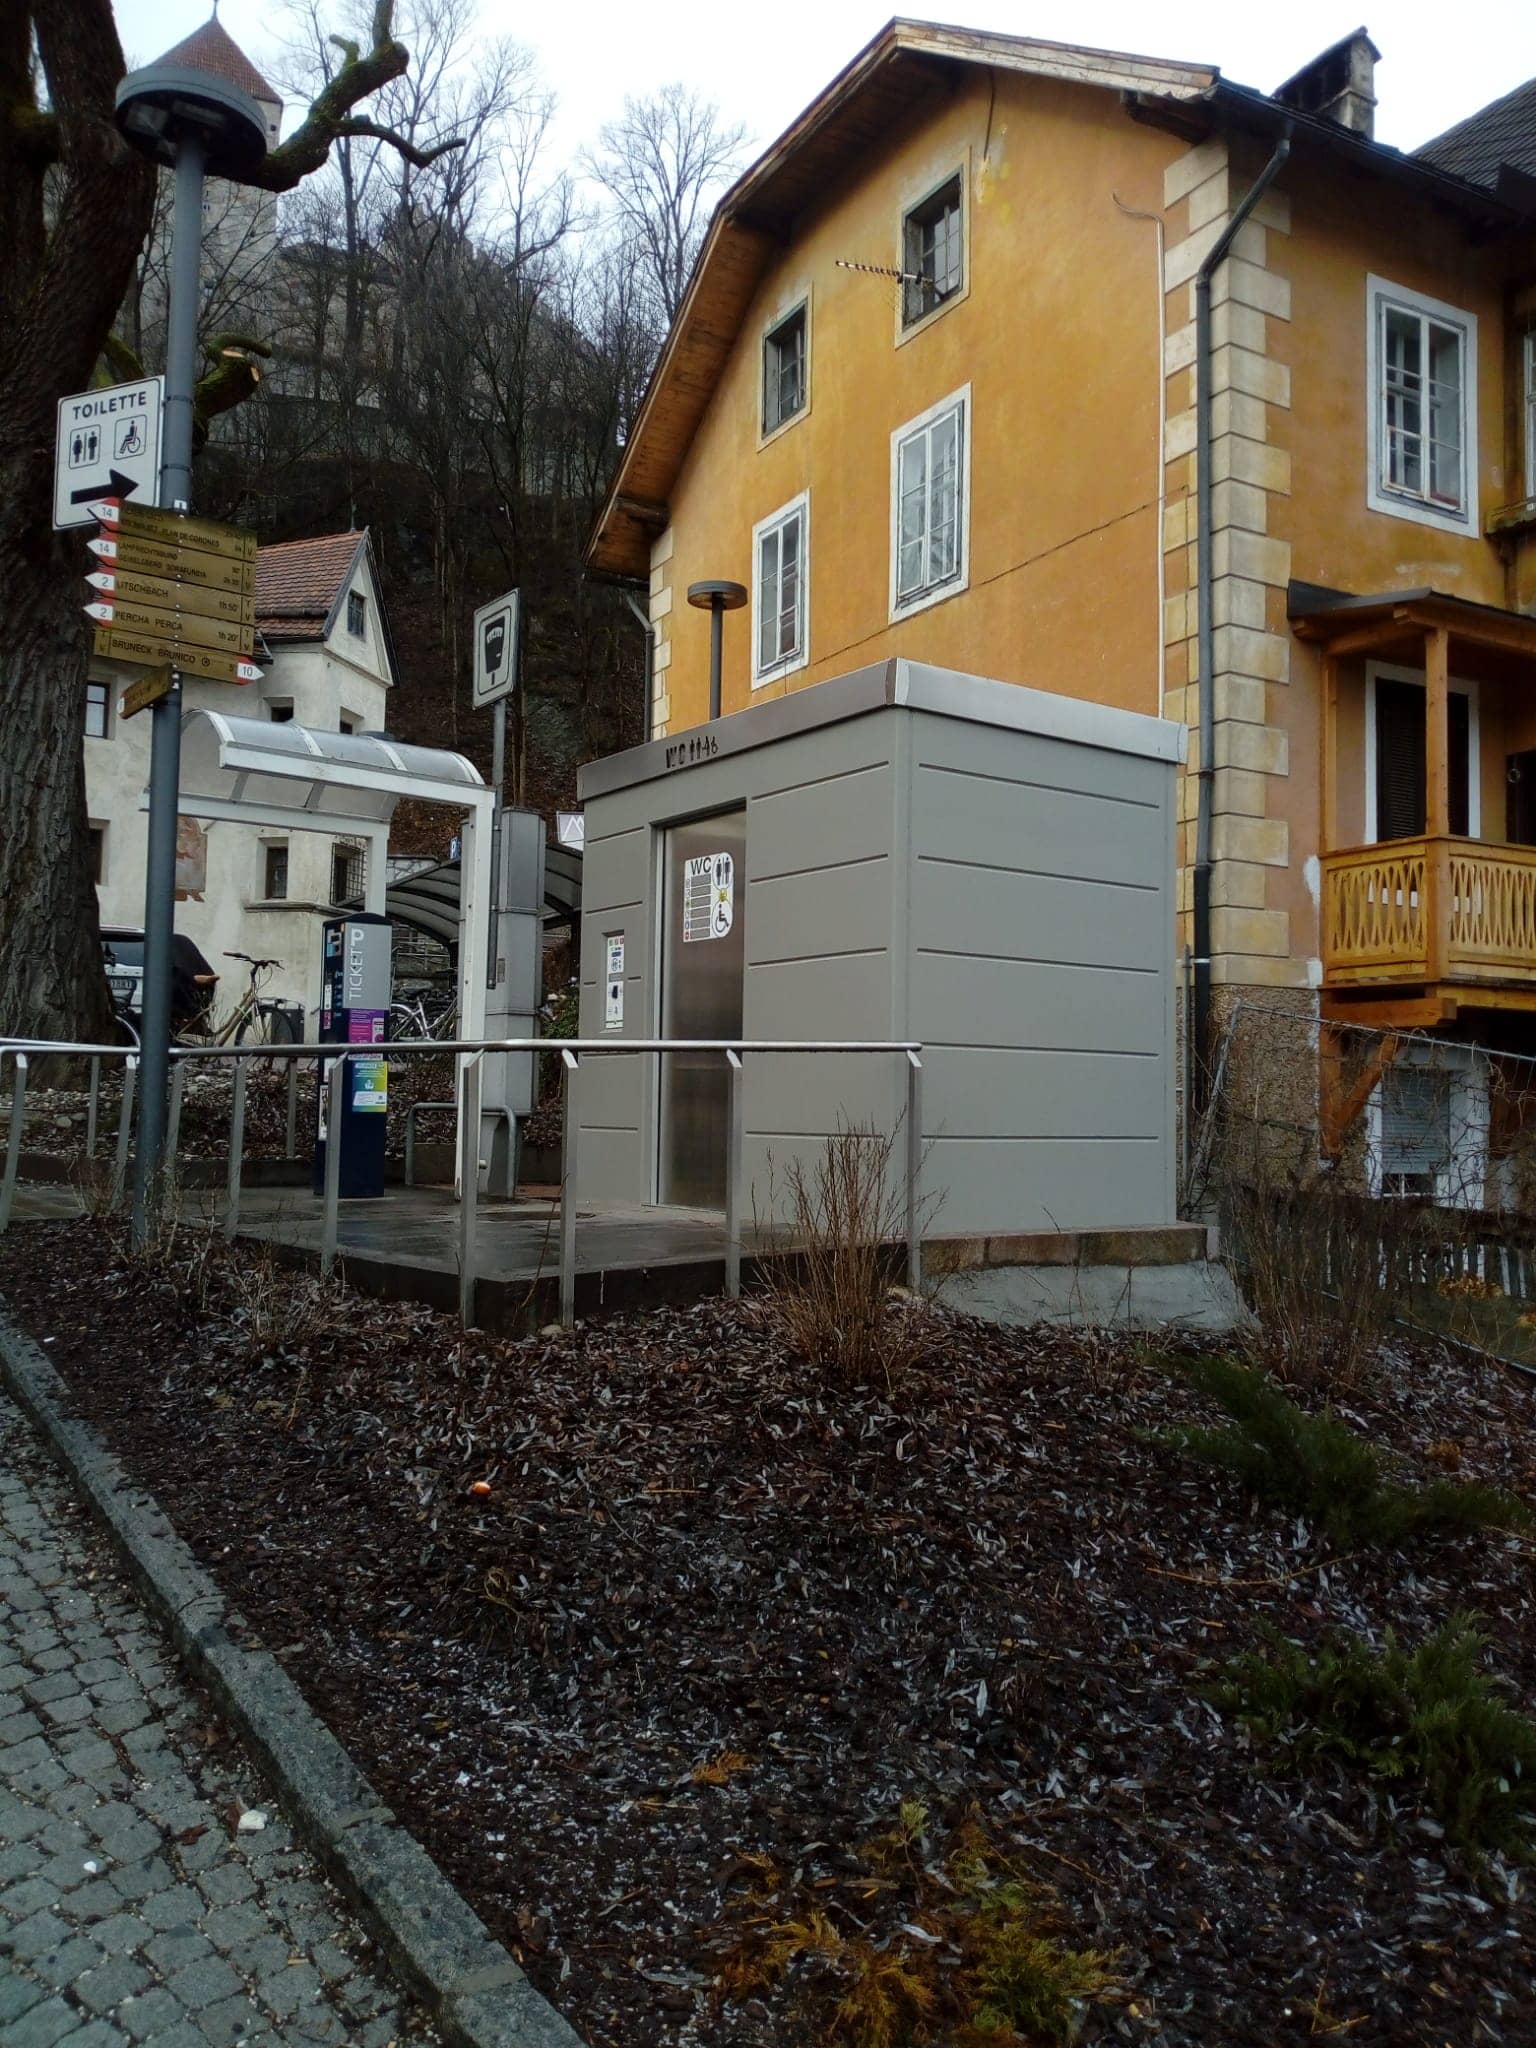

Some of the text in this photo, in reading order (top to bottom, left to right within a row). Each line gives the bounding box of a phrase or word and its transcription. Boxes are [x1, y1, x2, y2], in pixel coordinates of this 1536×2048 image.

[72, 391, 147, 420] TOILETTE
[102, 507, 113, 517] 14
[100, 543, 110, 553] 14
[102, 576, 109, 586] 2
[100, 607, 108, 617] 2
[242, 665, 253, 677] 10
[691, 857, 711, 875] WC
[351, 928, 364, 947] P
[349, 947, 362, 1001] TICKET
